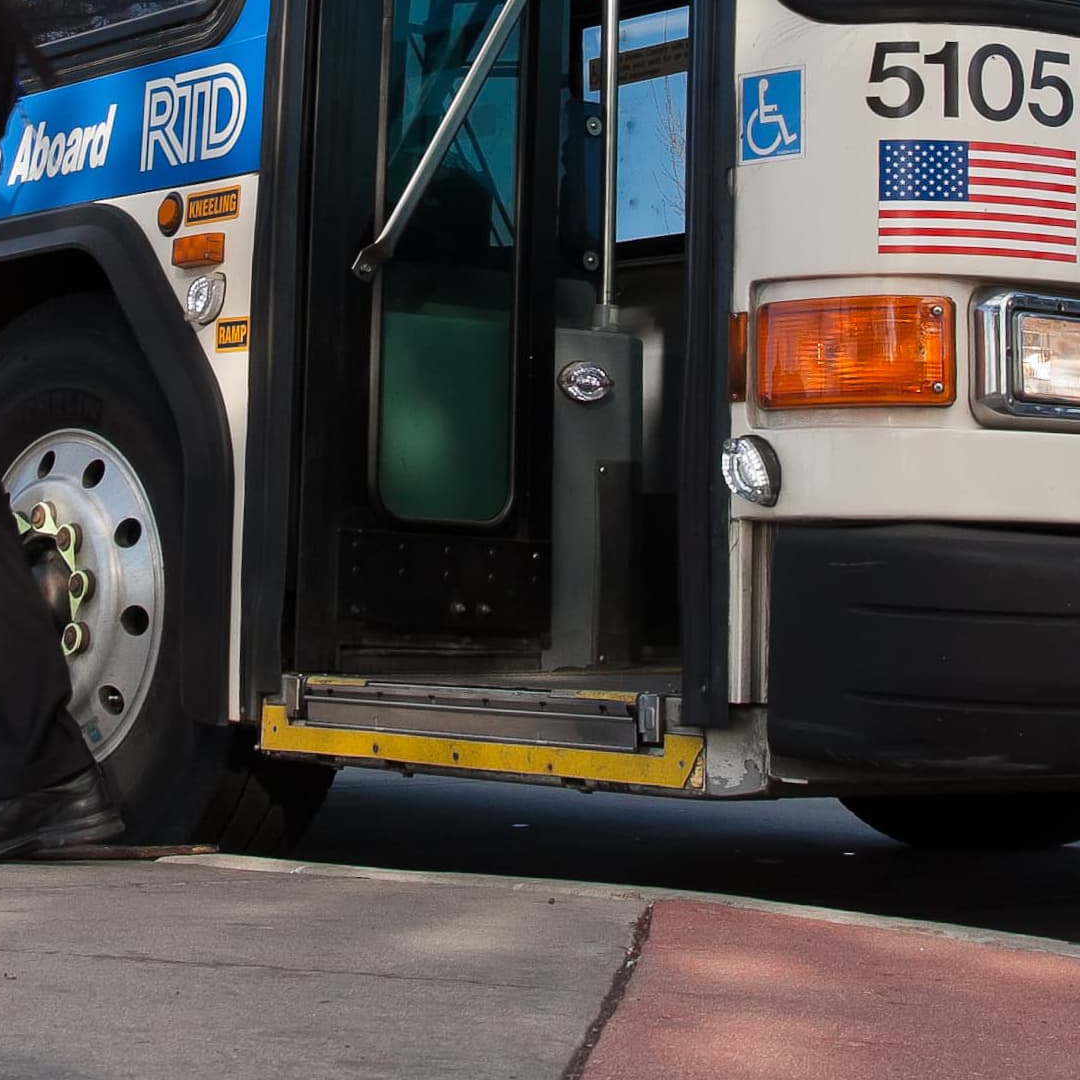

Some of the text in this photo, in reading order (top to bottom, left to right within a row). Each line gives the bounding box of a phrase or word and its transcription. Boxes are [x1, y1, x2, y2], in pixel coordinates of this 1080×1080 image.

[139, 62, 247, 172] RTD
[865, 41, 1074, 128] 5105
[7, 103, 117, 186] Aboard
[189, 193, 237, 219] KNEELING
[219, 324, 247, 344] RAMP
